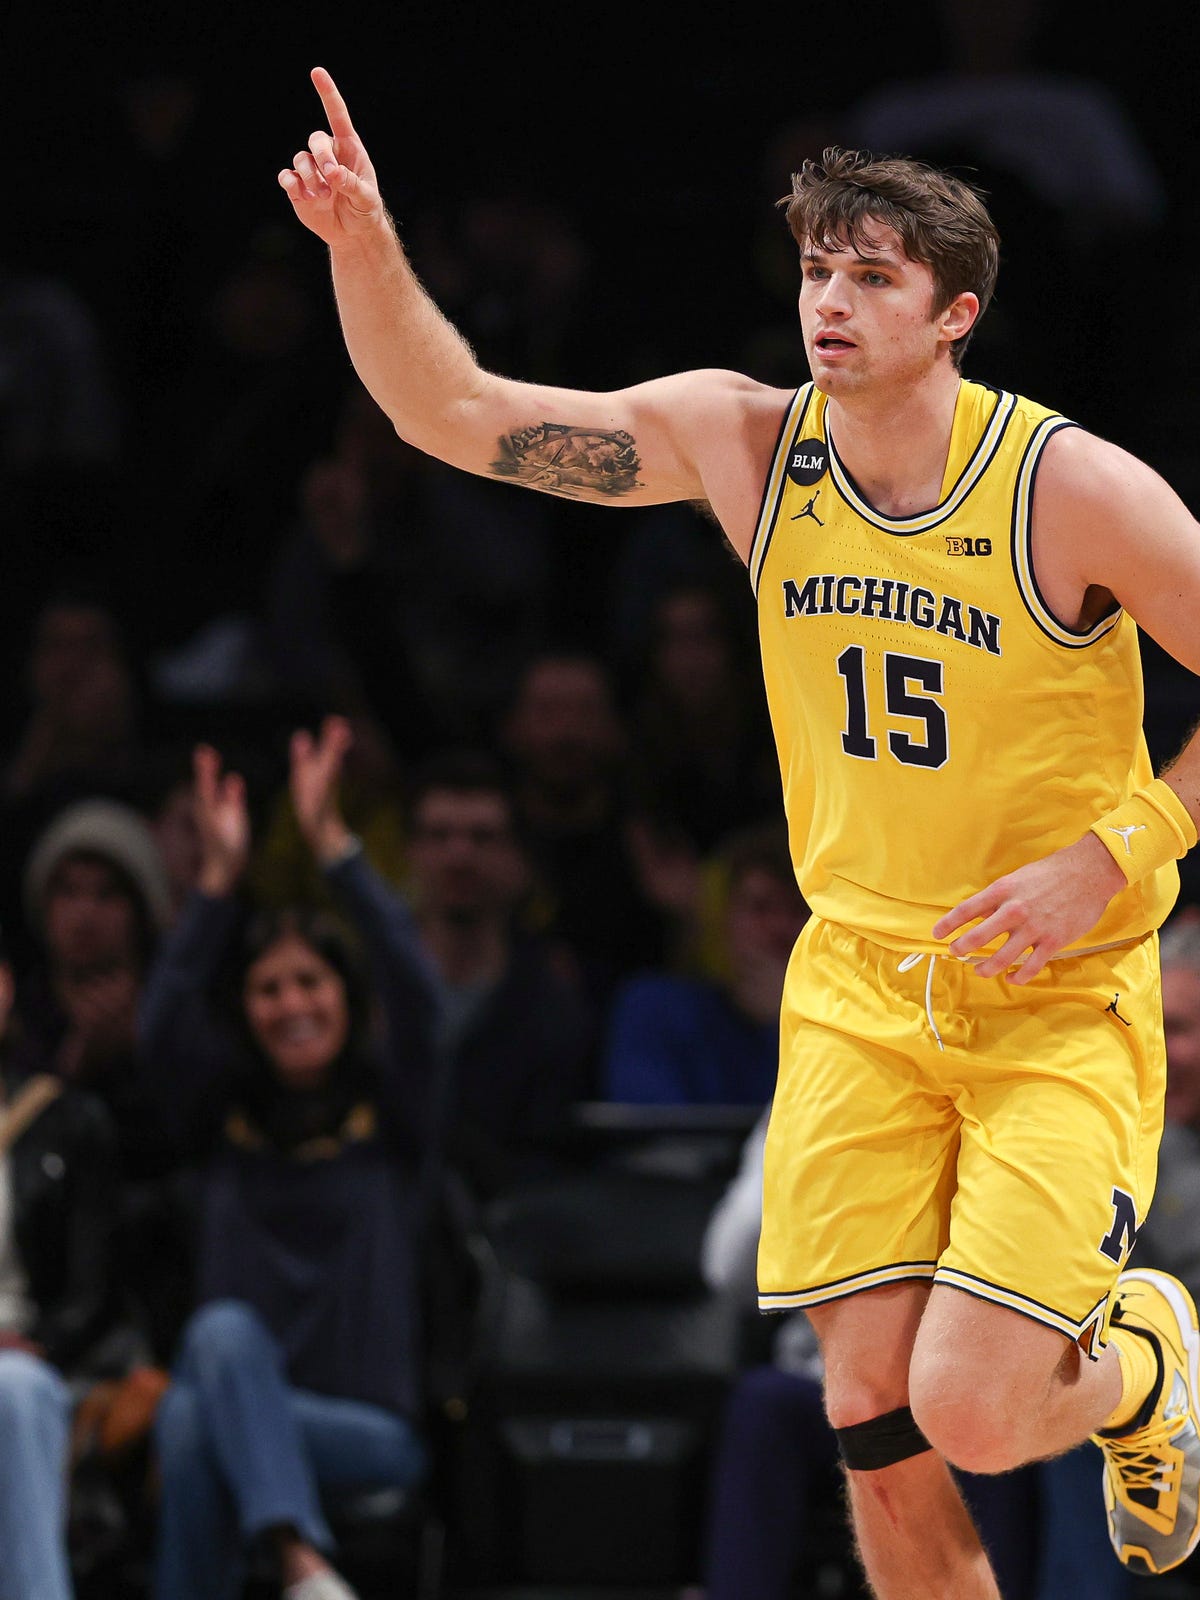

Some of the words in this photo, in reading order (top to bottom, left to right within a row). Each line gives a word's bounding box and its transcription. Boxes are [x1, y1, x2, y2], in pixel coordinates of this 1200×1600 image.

[791, 454, 824, 470] BLM
[782, 575, 1002, 657] MICHIGAN
[836, 644, 949, 770] 15
[1098, 1185, 1138, 1265] M
